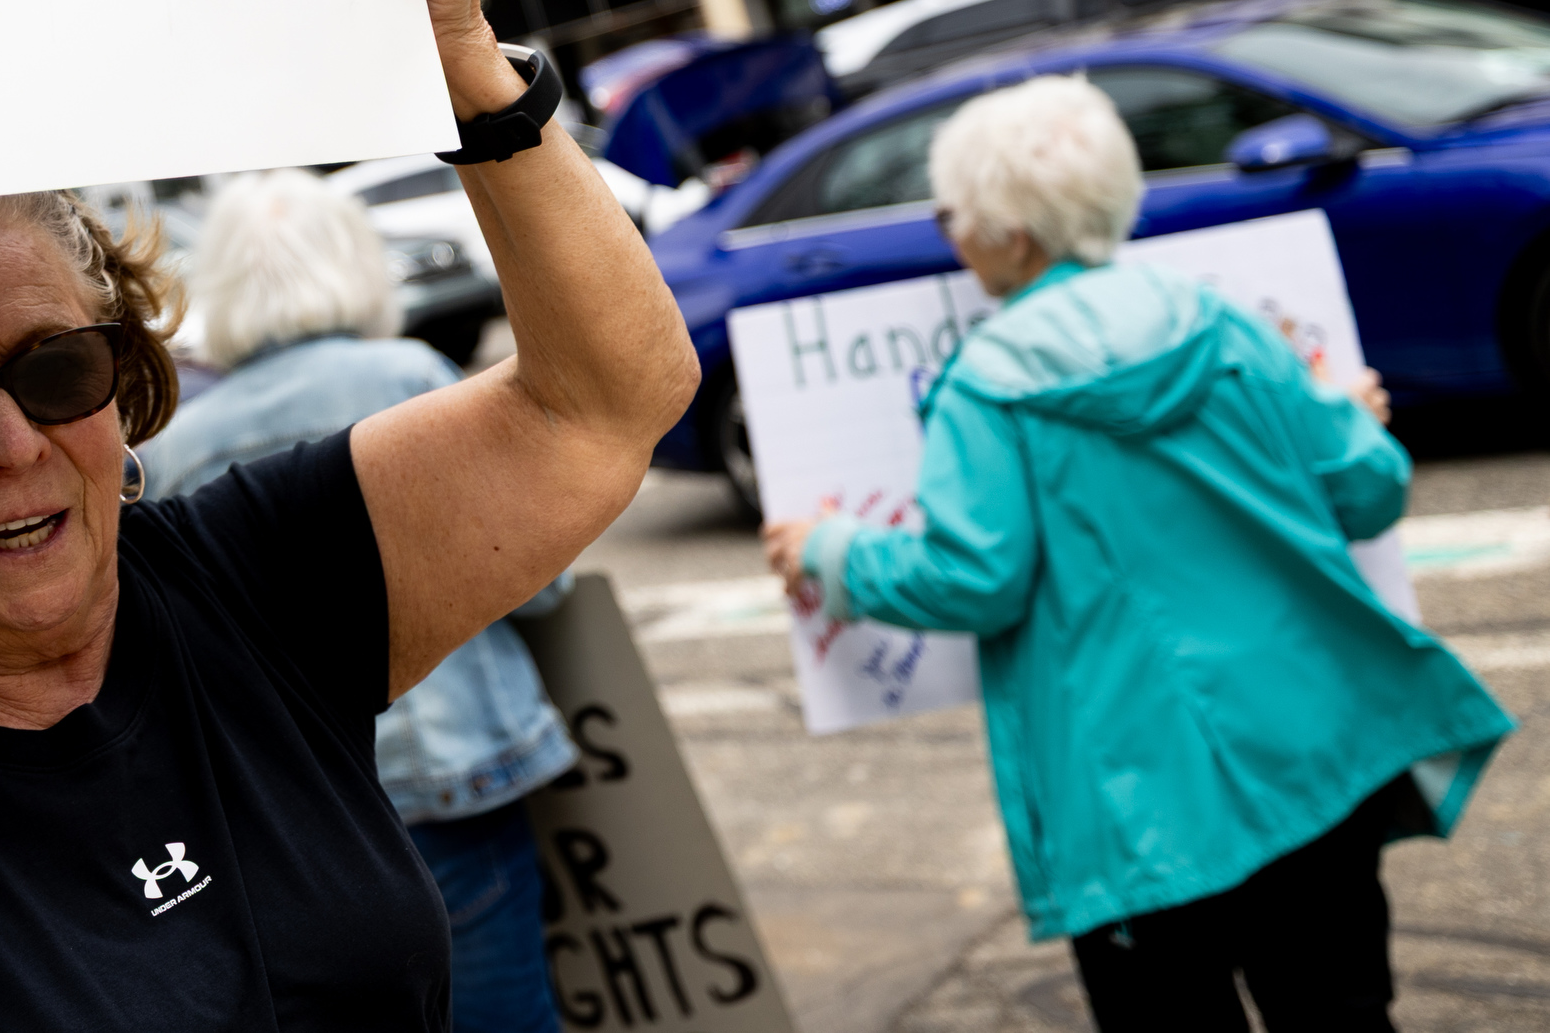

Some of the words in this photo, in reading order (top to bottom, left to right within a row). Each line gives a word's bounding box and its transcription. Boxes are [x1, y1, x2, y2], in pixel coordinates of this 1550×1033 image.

[151, 899, 177, 916] UNDER
[177, 875, 212, 903] ARMOUR
[544, 899, 759, 1029] GHTS
